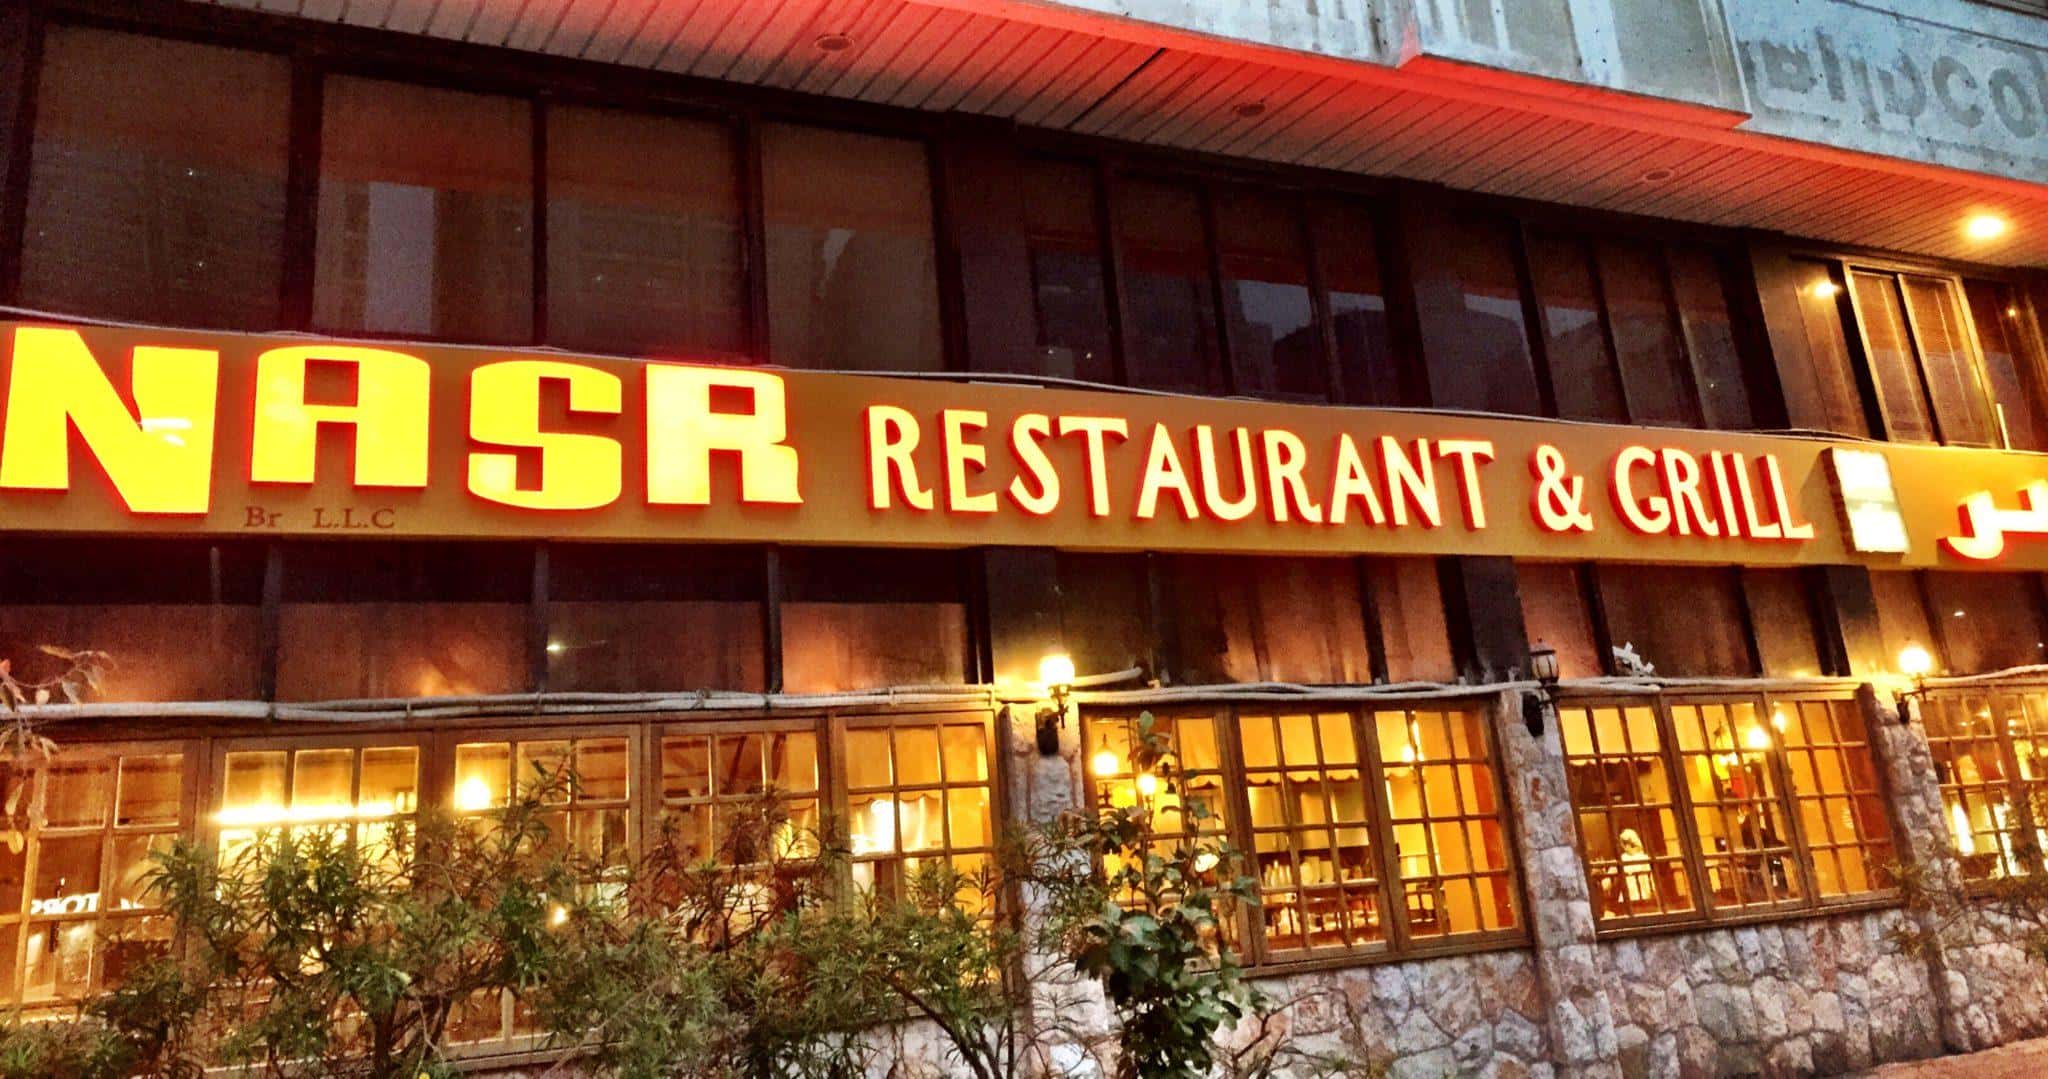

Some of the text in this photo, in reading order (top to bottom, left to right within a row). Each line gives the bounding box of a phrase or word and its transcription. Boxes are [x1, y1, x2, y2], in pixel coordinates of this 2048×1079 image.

[0, 326, 1816, 541] NASR RESTAURANT & GRILL
[244, 505, 396, 529] Br L.L.C
